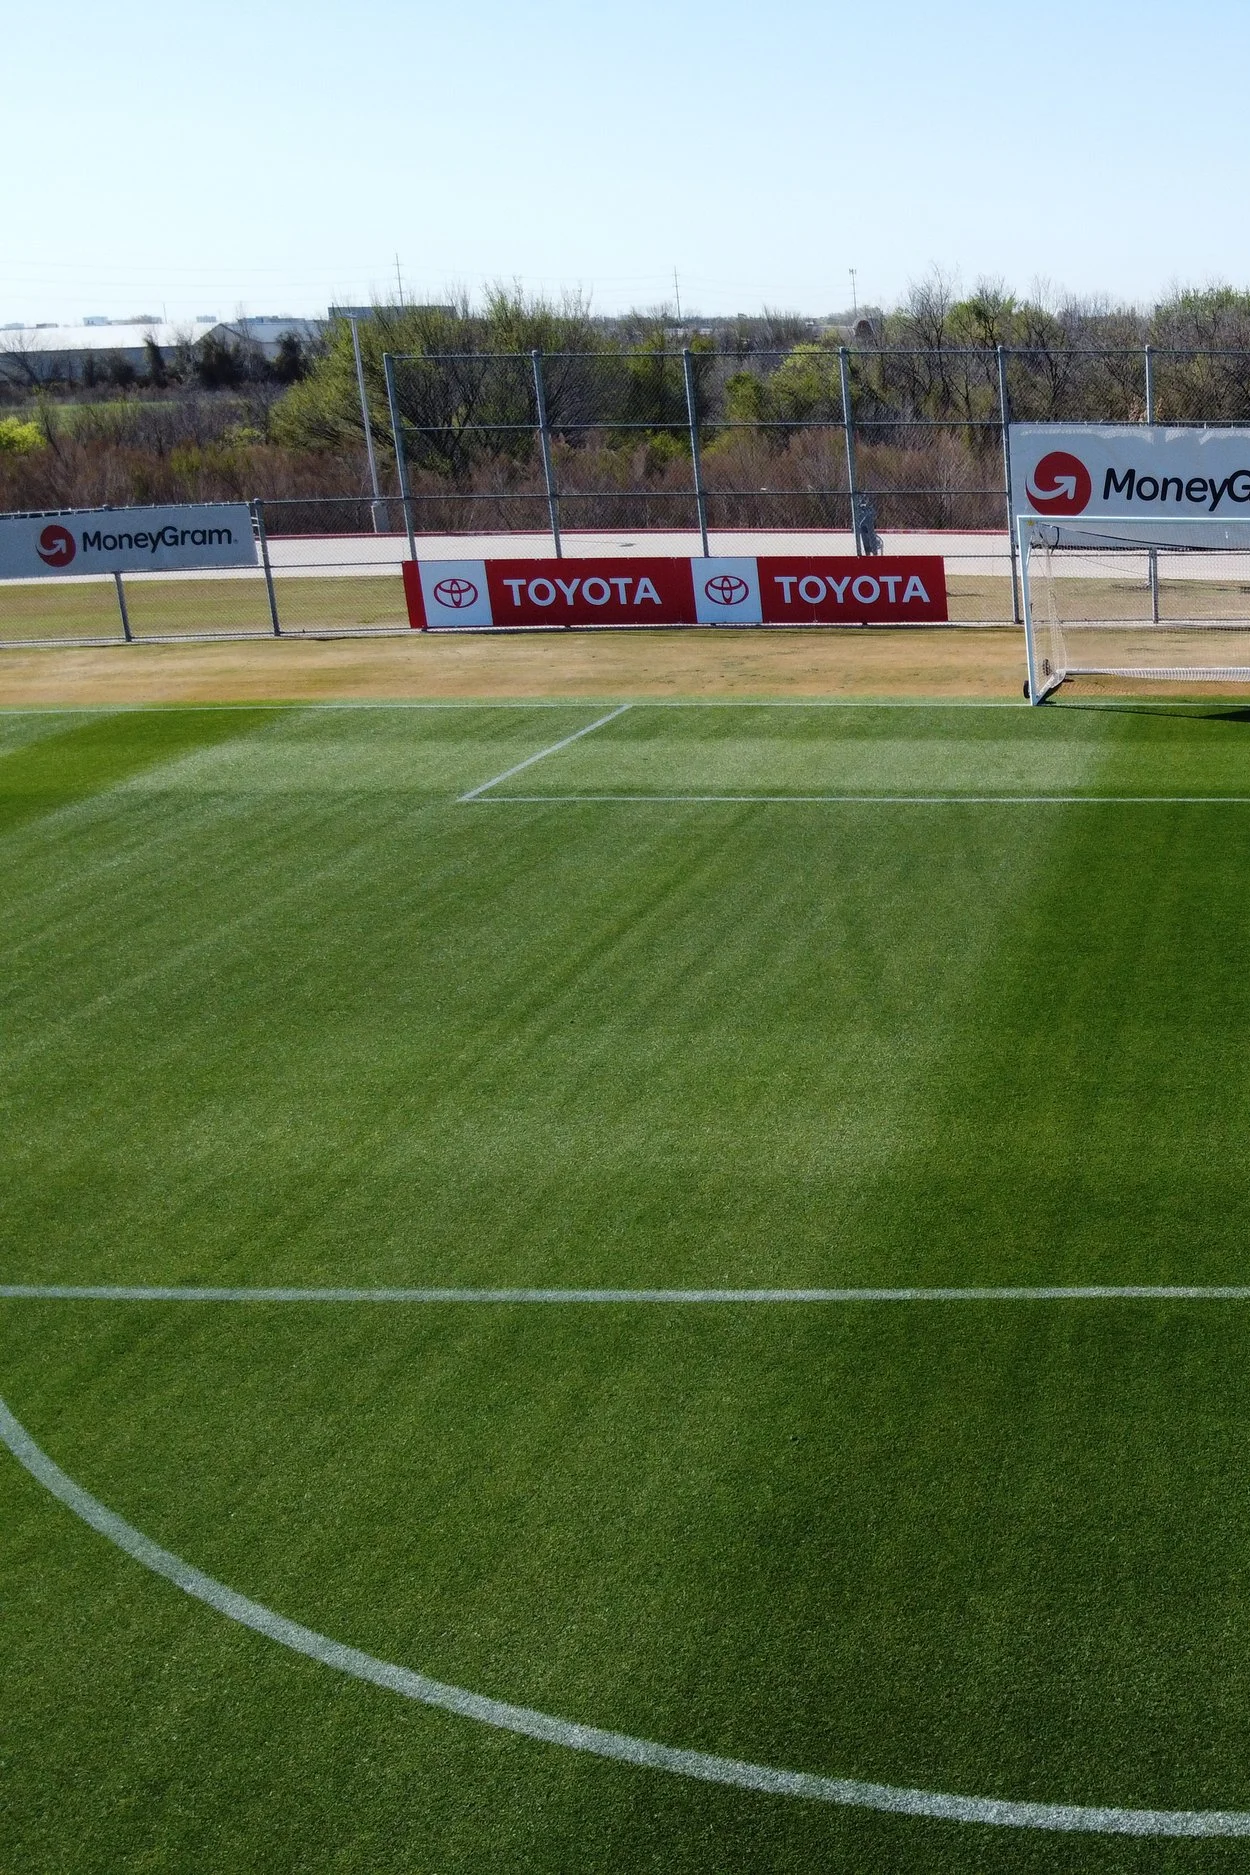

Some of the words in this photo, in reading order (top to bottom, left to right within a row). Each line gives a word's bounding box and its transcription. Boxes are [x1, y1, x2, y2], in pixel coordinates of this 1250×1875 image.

[82, 525, 232, 553] MoneyGram
[503, 577, 662, 607] TOYOTA
[774, 575, 930, 605] TOYOTA
